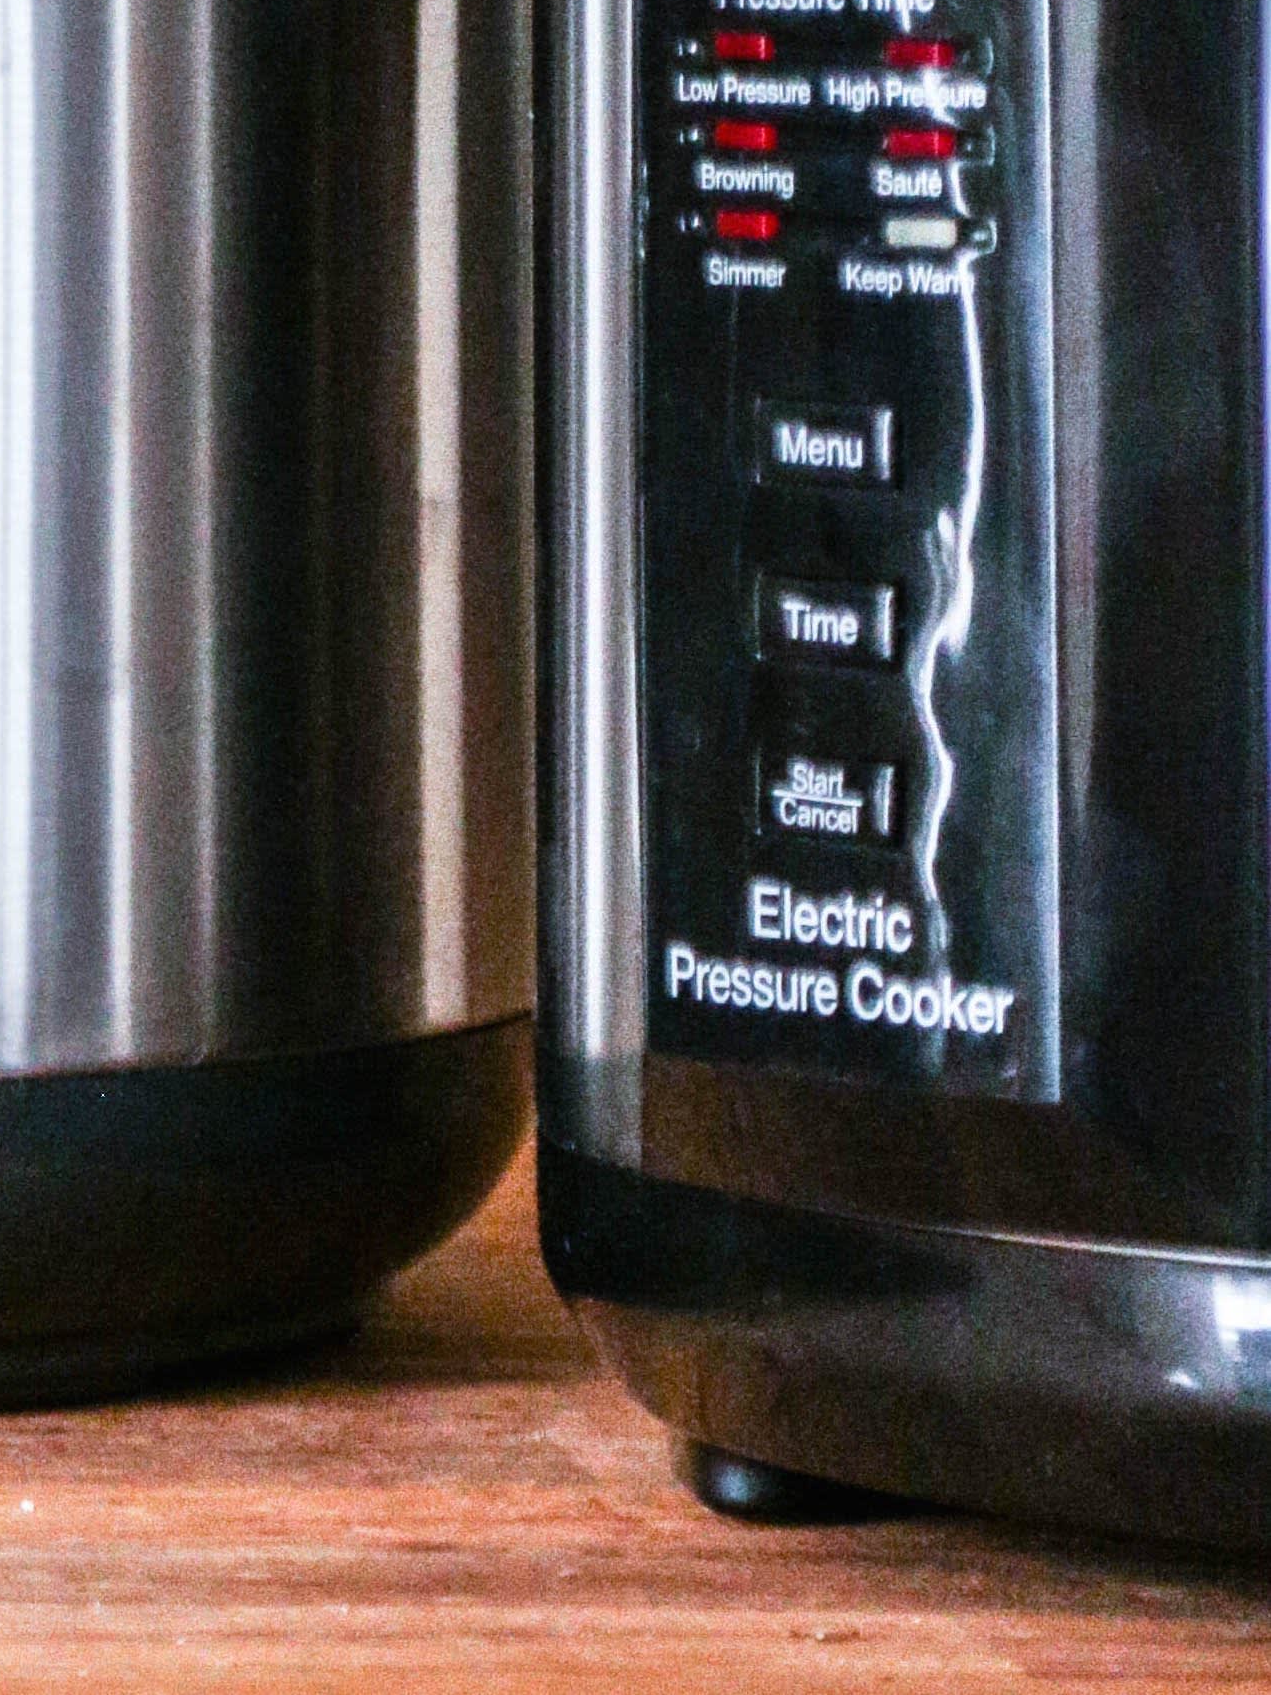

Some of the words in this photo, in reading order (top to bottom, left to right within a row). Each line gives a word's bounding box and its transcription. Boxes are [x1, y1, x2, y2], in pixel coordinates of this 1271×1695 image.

[678, 73, 716, 102] Low
[723, 75, 811, 106] Pressure
[828, 75, 880, 113] High
[699, 162, 795, 199] Browning
[708, 259, 786, 288] Simmer
[845, 262, 903, 298] Keep
[777, 424, 864, 468] Menu
[782, 597, 859, 646] Time
[790, 762, 844, 797] Start
[778, 797, 859, 834] Cancel
[751, 883, 913, 953] Electric
[667, 943, 838, 1016] Pressure
[850, 963, 1014, 1035] Cooker
